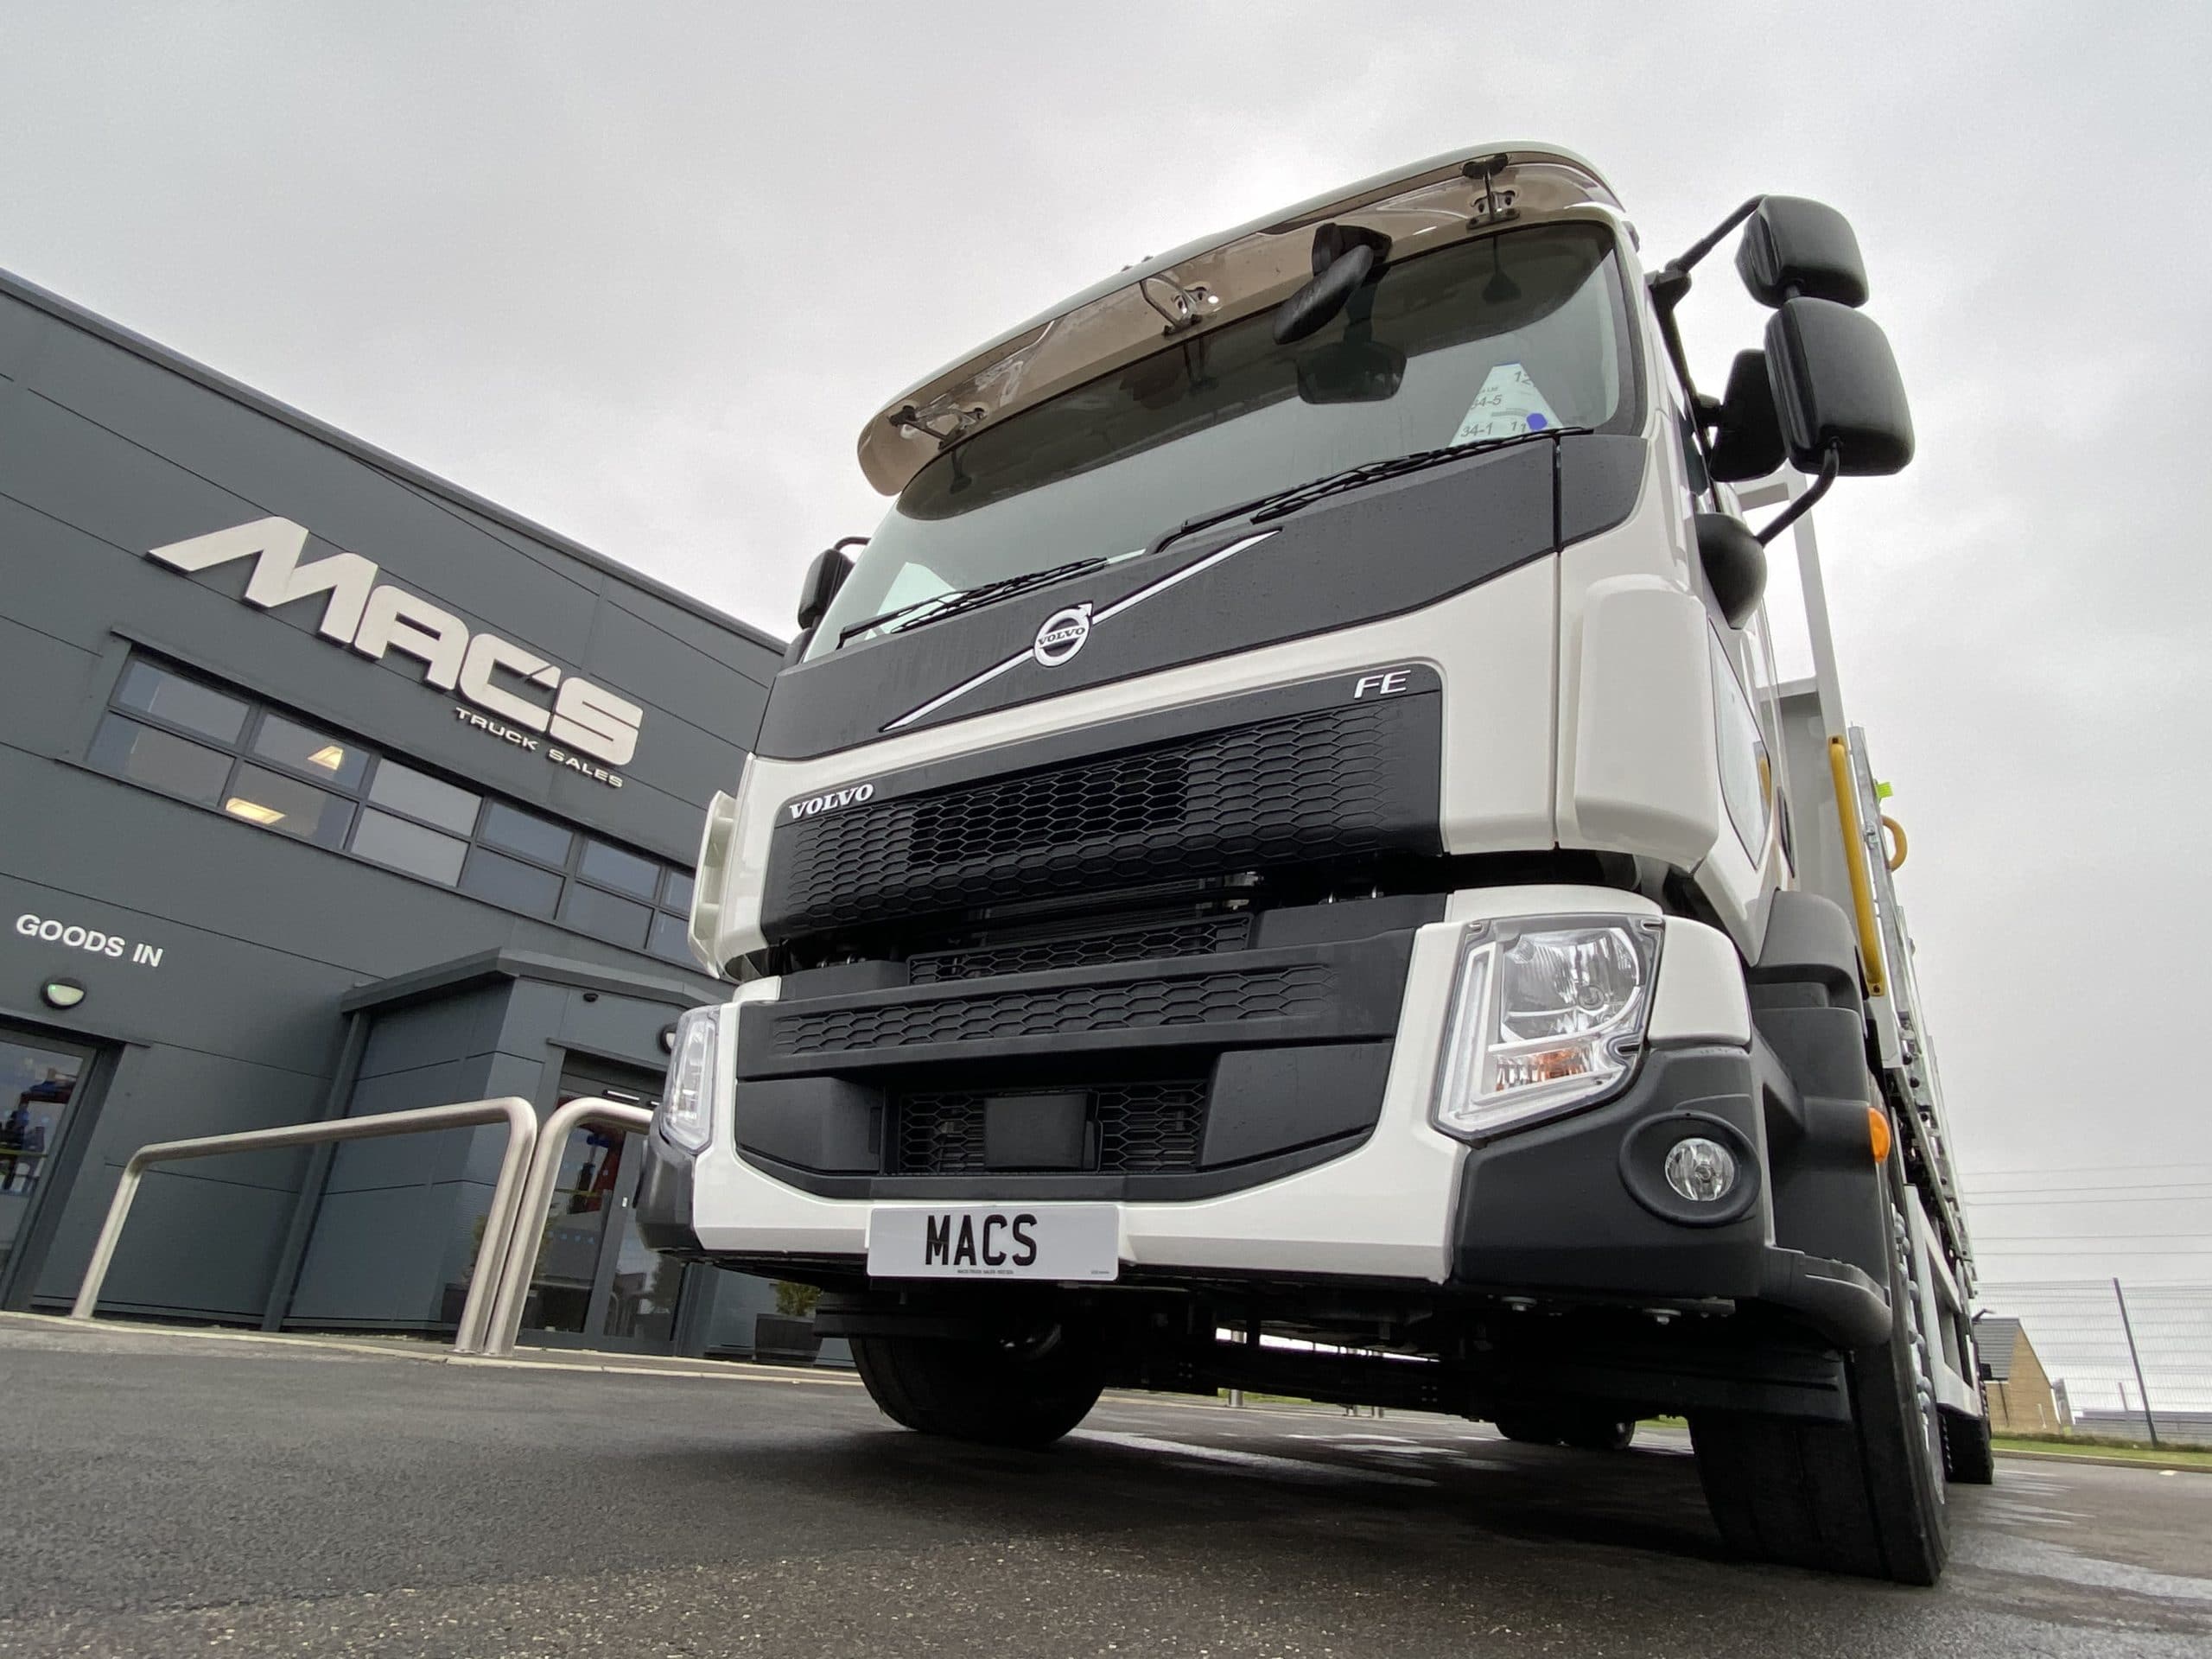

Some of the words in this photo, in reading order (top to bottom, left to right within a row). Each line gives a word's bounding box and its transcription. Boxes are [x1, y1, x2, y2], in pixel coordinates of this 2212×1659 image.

[146, 516, 645, 767] MACS
[1038, 626, 1086, 645] VOLVO
[1354, 669, 1412, 699] FE
[455, 707, 539, 751] TRUCK
[548, 748, 624, 788] SALES
[789, 783, 874, 819] VOLVO
[16, 913, 126, 957] GOODS
[132, 943, 163, 968] IN
[925, 1213, 1038, 1267] MACS
